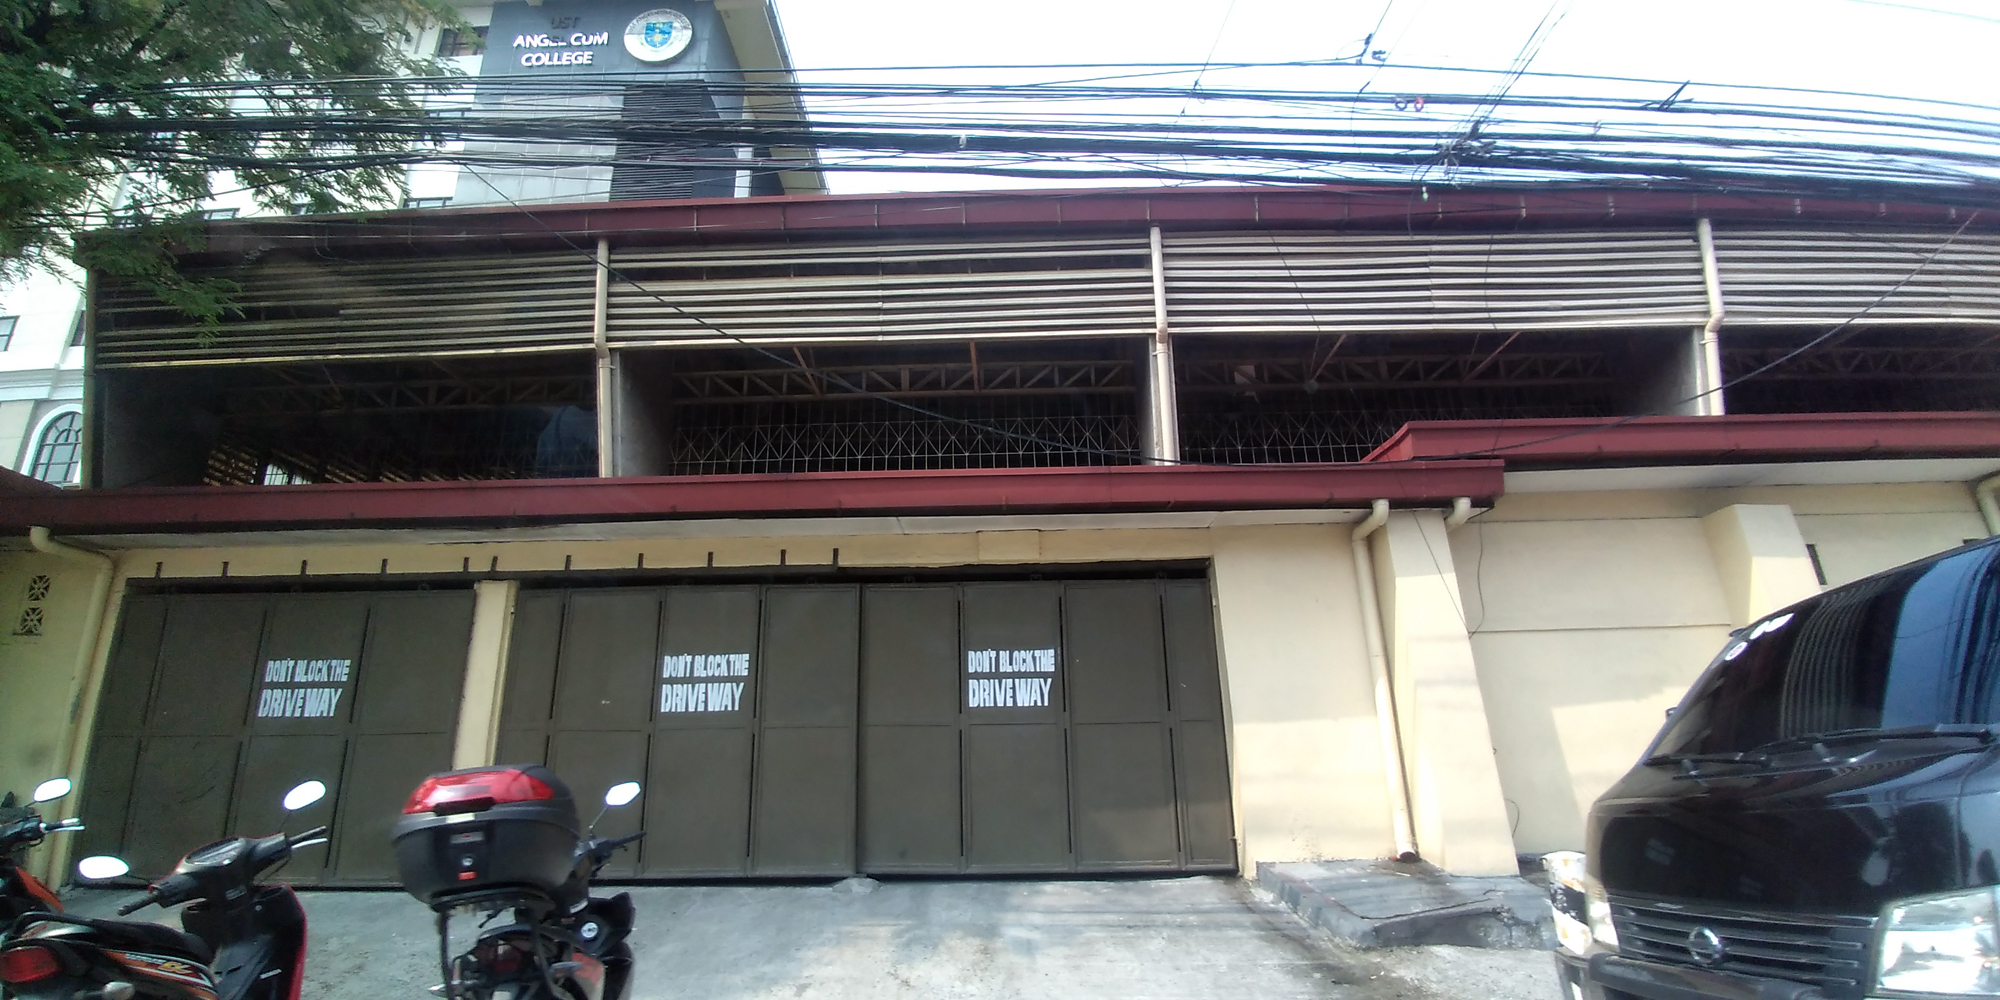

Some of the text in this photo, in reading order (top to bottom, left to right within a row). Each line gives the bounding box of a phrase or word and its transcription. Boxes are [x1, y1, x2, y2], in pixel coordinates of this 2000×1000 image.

[551, 17, 581, 30] UST
[521, 51, 594, 67] COLLEGE
[265, 658, 351, 682] DON'T BLOCK THE
[663, 653, 750, 678] DON'T BLOCK THE
[968, 648, 1055, 673] DON'T BLOCK THE
